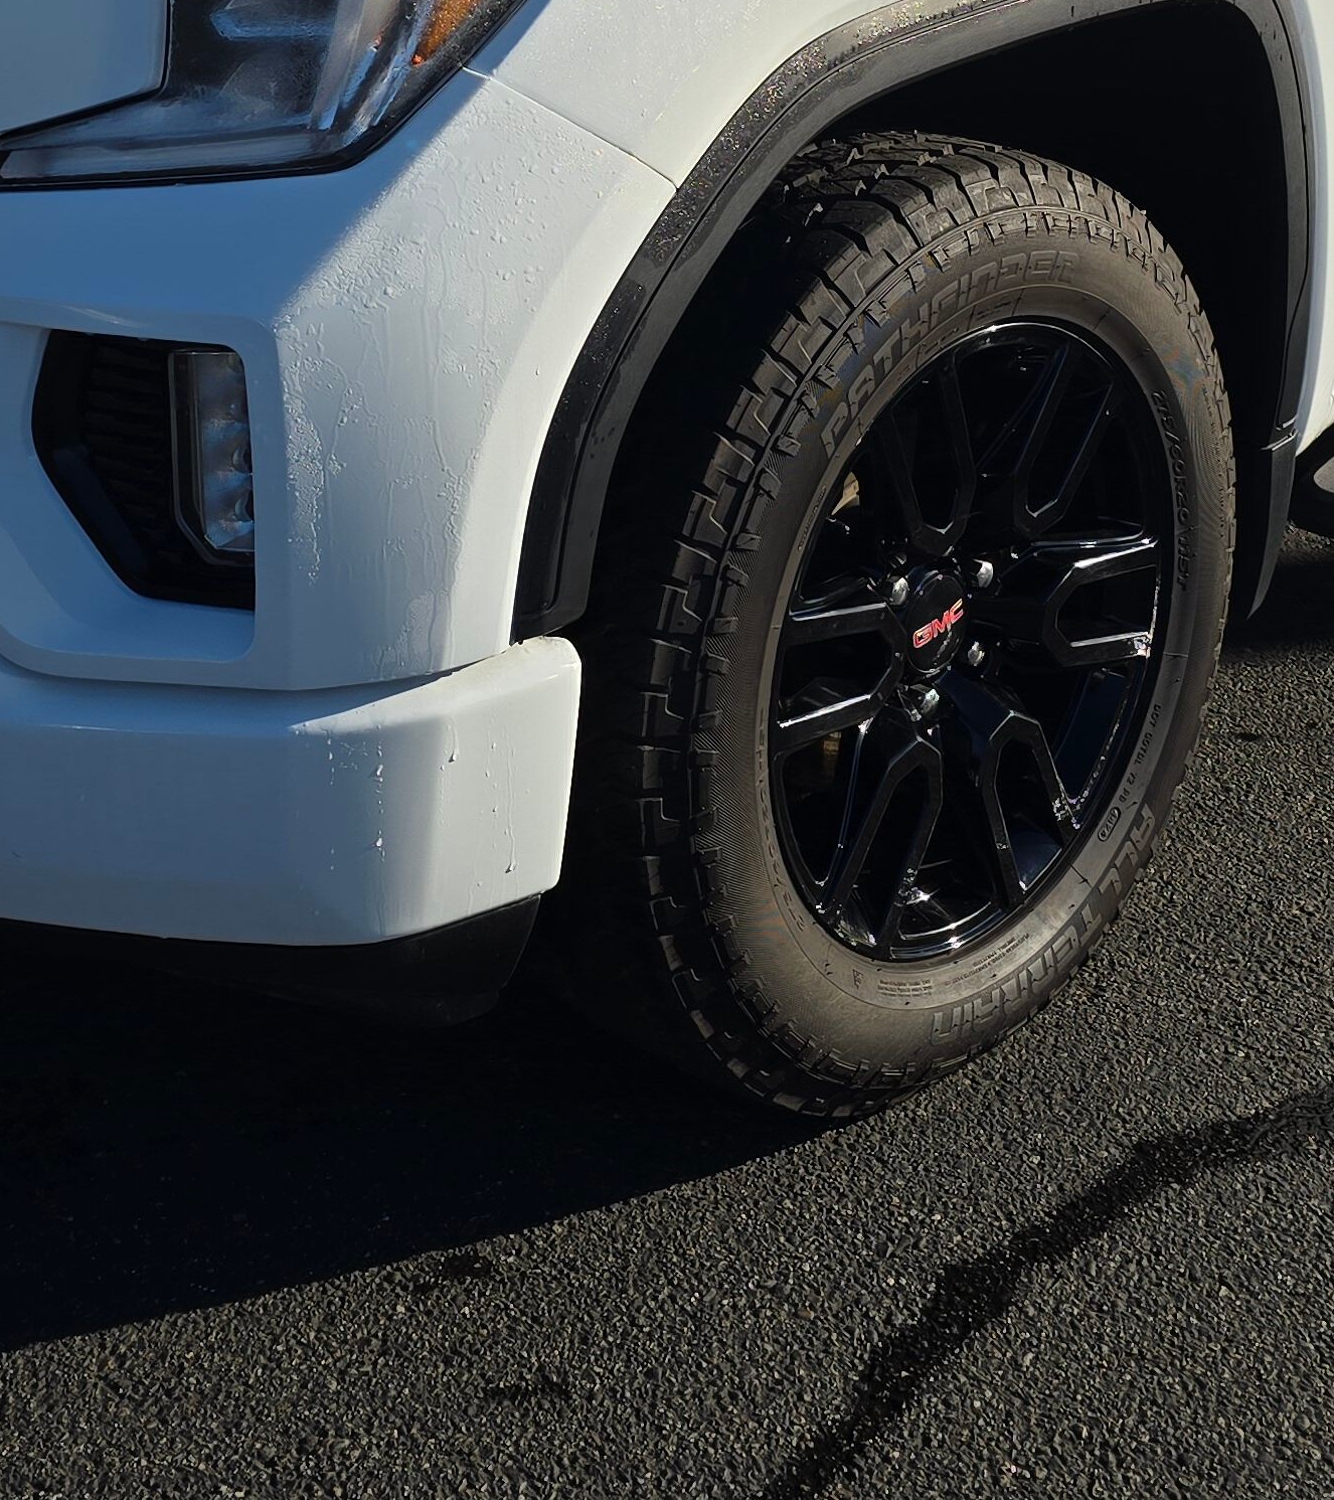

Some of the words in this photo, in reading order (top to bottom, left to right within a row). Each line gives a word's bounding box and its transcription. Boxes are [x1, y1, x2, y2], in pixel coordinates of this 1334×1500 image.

[820, 249, 1079, 460] PATHFINDER
[913, 598, 964, 649] GMC
[1098, 803, 1156, 896] ALL
[931, 902, 1103, 1046] TERRAIN
